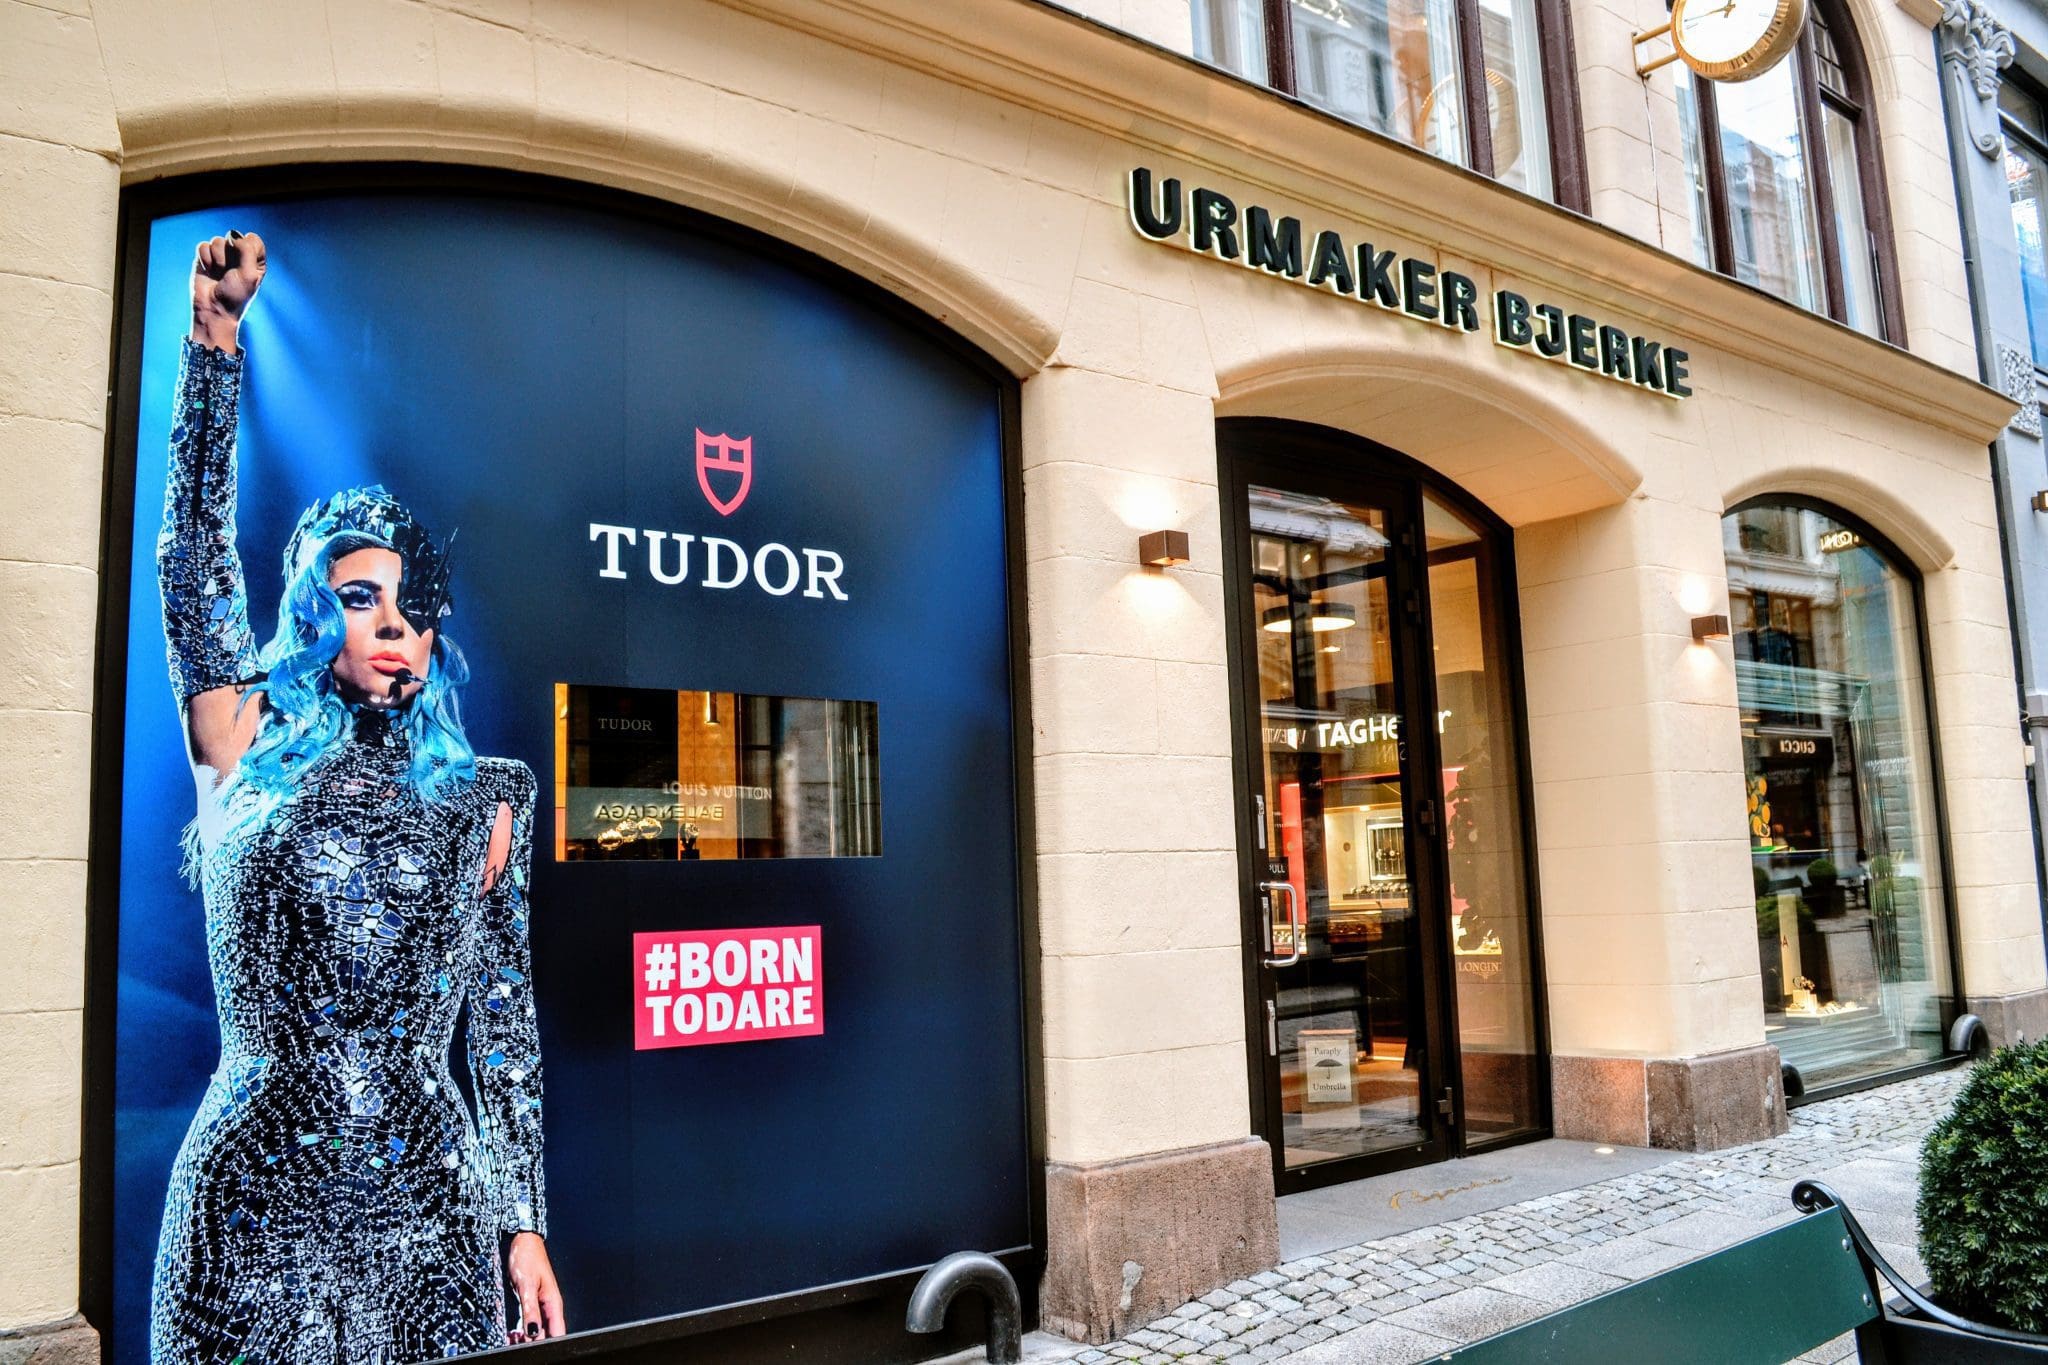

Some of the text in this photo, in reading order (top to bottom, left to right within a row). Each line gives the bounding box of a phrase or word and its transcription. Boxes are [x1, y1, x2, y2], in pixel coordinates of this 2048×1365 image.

[1128, 166, 1693, 400] URMAKER BJERKE
[589, 522, 849, 601] TUDOR
[598, 717, 653, 731] TUDOR
[662, 781, 772, 800] LOUIS VUITTON
[644, 936, 814, 992] #BORN
[645, 986, 815, 1037] TODARE
[1312, 1082, 1347, 1091] Umbrella
